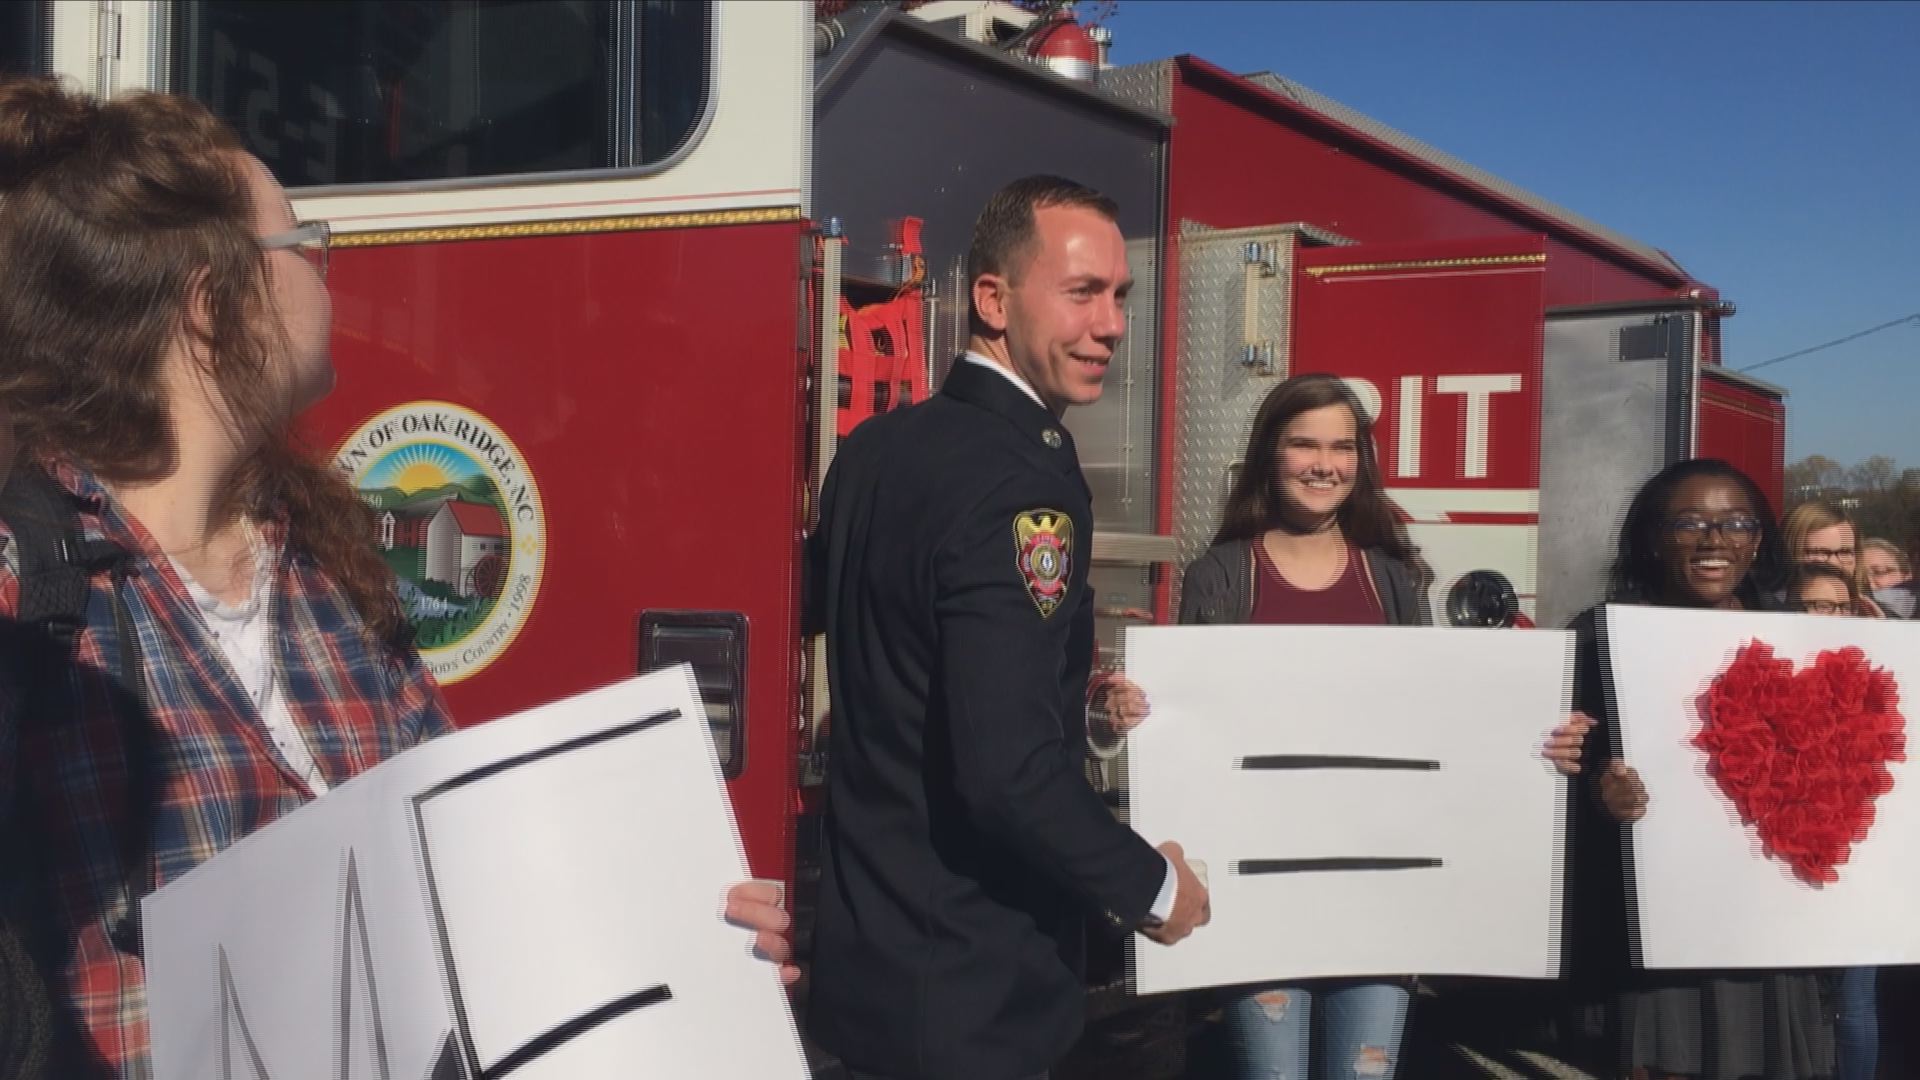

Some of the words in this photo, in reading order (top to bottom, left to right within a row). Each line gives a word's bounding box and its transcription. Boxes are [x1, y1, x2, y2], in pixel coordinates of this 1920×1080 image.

[368, 421, 396, 450] OF
[402, 413, 448, 434] OAK
[510, 484, 534, 522] NC
[1340, 373, 1522, 478] IT
